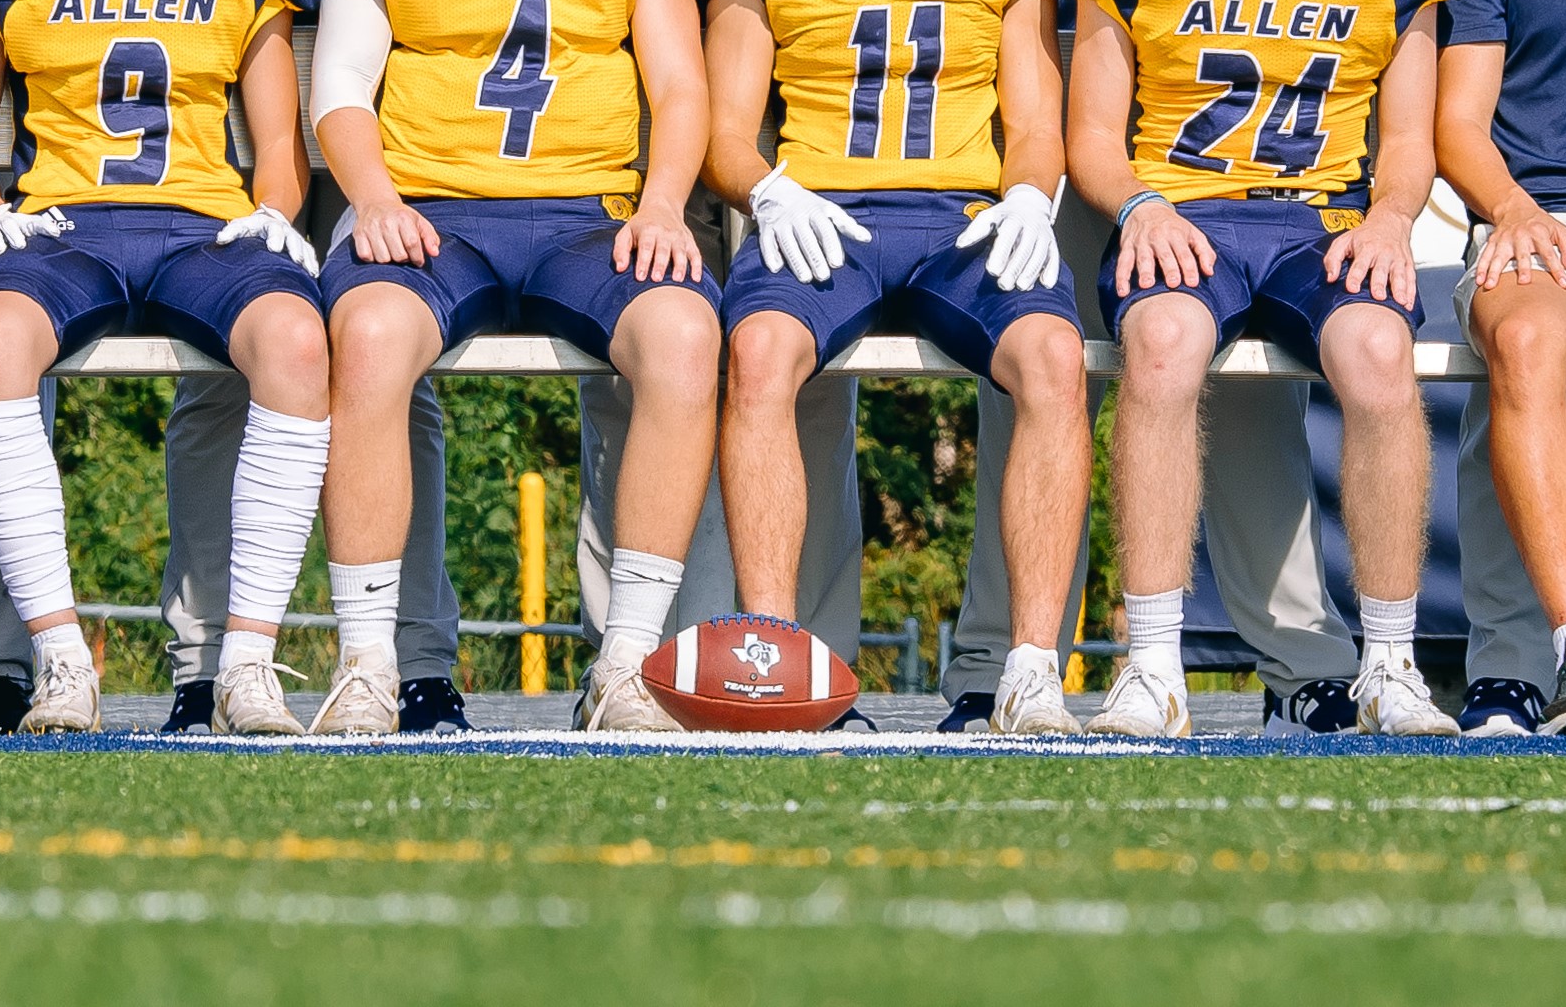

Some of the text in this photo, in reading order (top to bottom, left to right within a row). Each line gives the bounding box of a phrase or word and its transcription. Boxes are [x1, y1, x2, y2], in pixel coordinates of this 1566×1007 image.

[96, 38, 173, 187] 9
[844, 1, 946, 161] 11
[1166, 48, 1341, 179] 24
